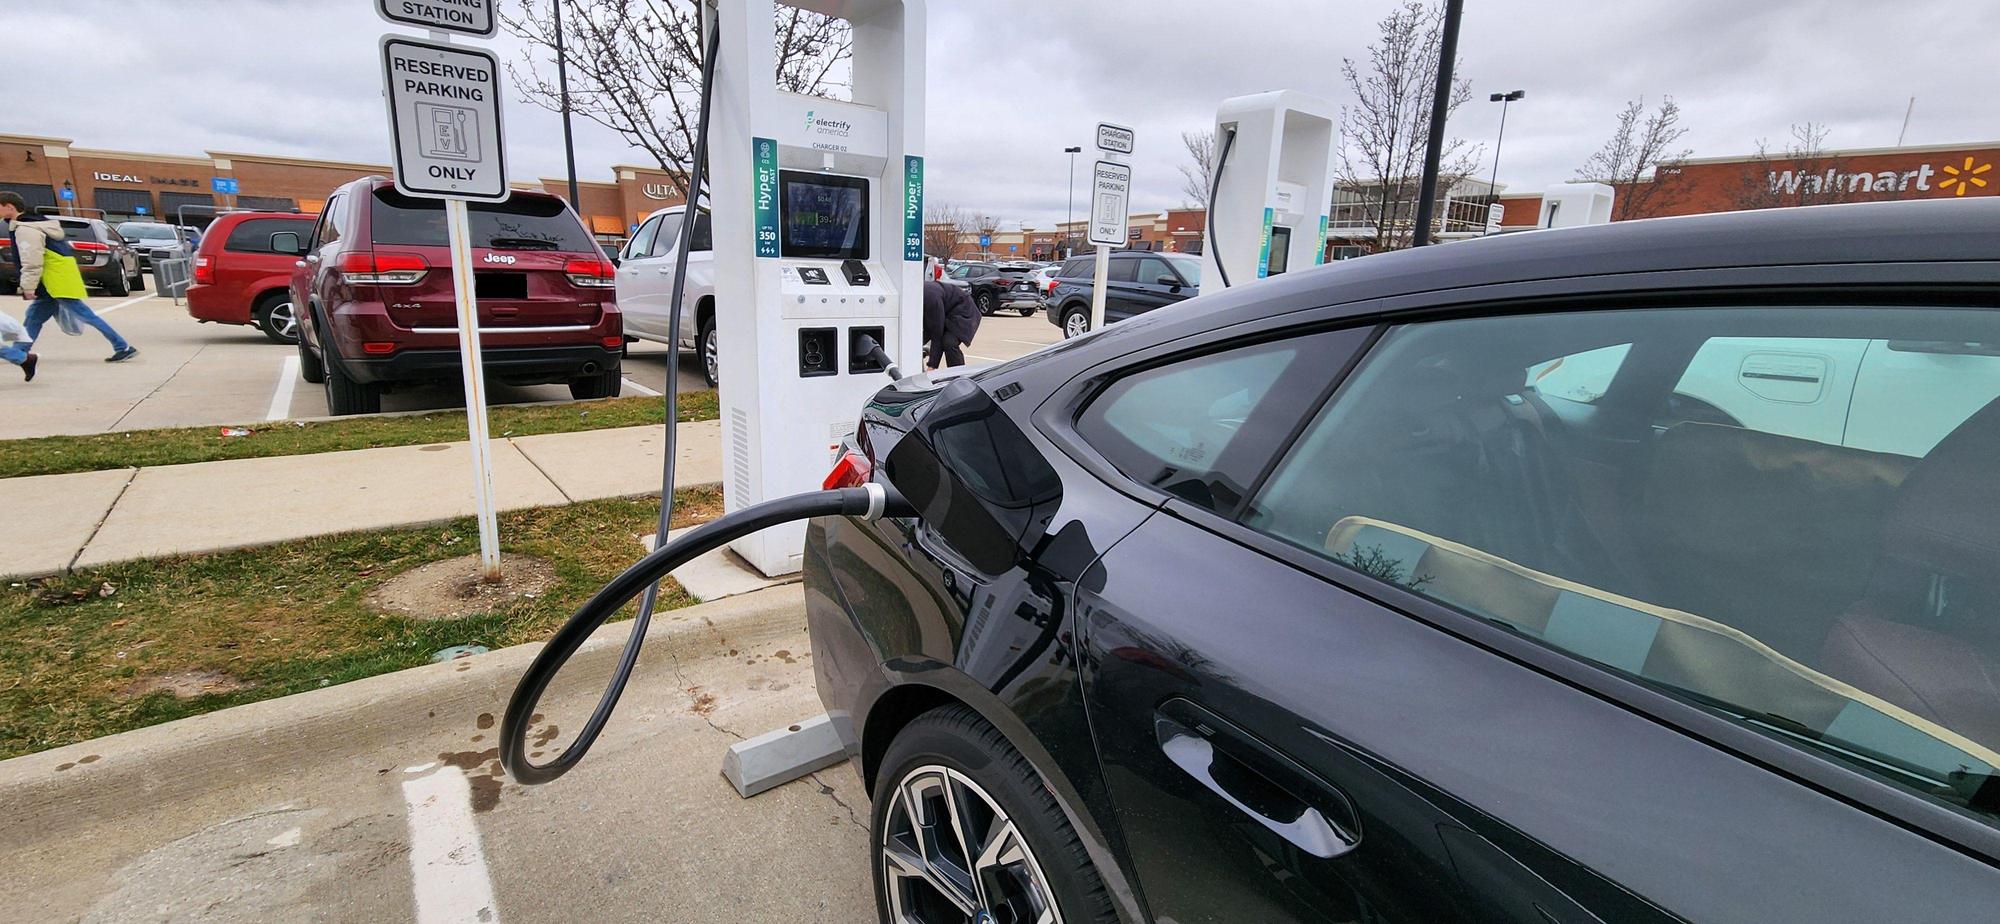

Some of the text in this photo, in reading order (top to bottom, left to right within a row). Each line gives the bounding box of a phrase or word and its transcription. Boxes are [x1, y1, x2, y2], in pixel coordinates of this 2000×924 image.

[403, 2, 473, 24] STATION
[394, 57, 489, 82] RESERVED
[405, 80, 483, 101] PARKING
[816, 118, 851, 131] electrify
[817, 127, 849, 137] america
[1101, 129, 1131, 141] CHARGING
[813, 143, 839, 151] CHARGER
[1104, 138, 1127, 149] STATION
[428, 165, 477, 181] ONLY
[1097, 170, 1128, 182] RESERVED
[1769, 164, 1935, 195] Walmart
[647, 183, 678, 196] ULTA
[758, 167, 771, 210] Hyper
[1099, 181, 1125, 192] PARKING
[907, 181, 917, 219] Hyper
[759, 231, 776, 241] 350
[1100, 226, 1116, 235] ONLY
[906, 237, 920, 246] 350
[483, 252, 516, 265] Jeep
